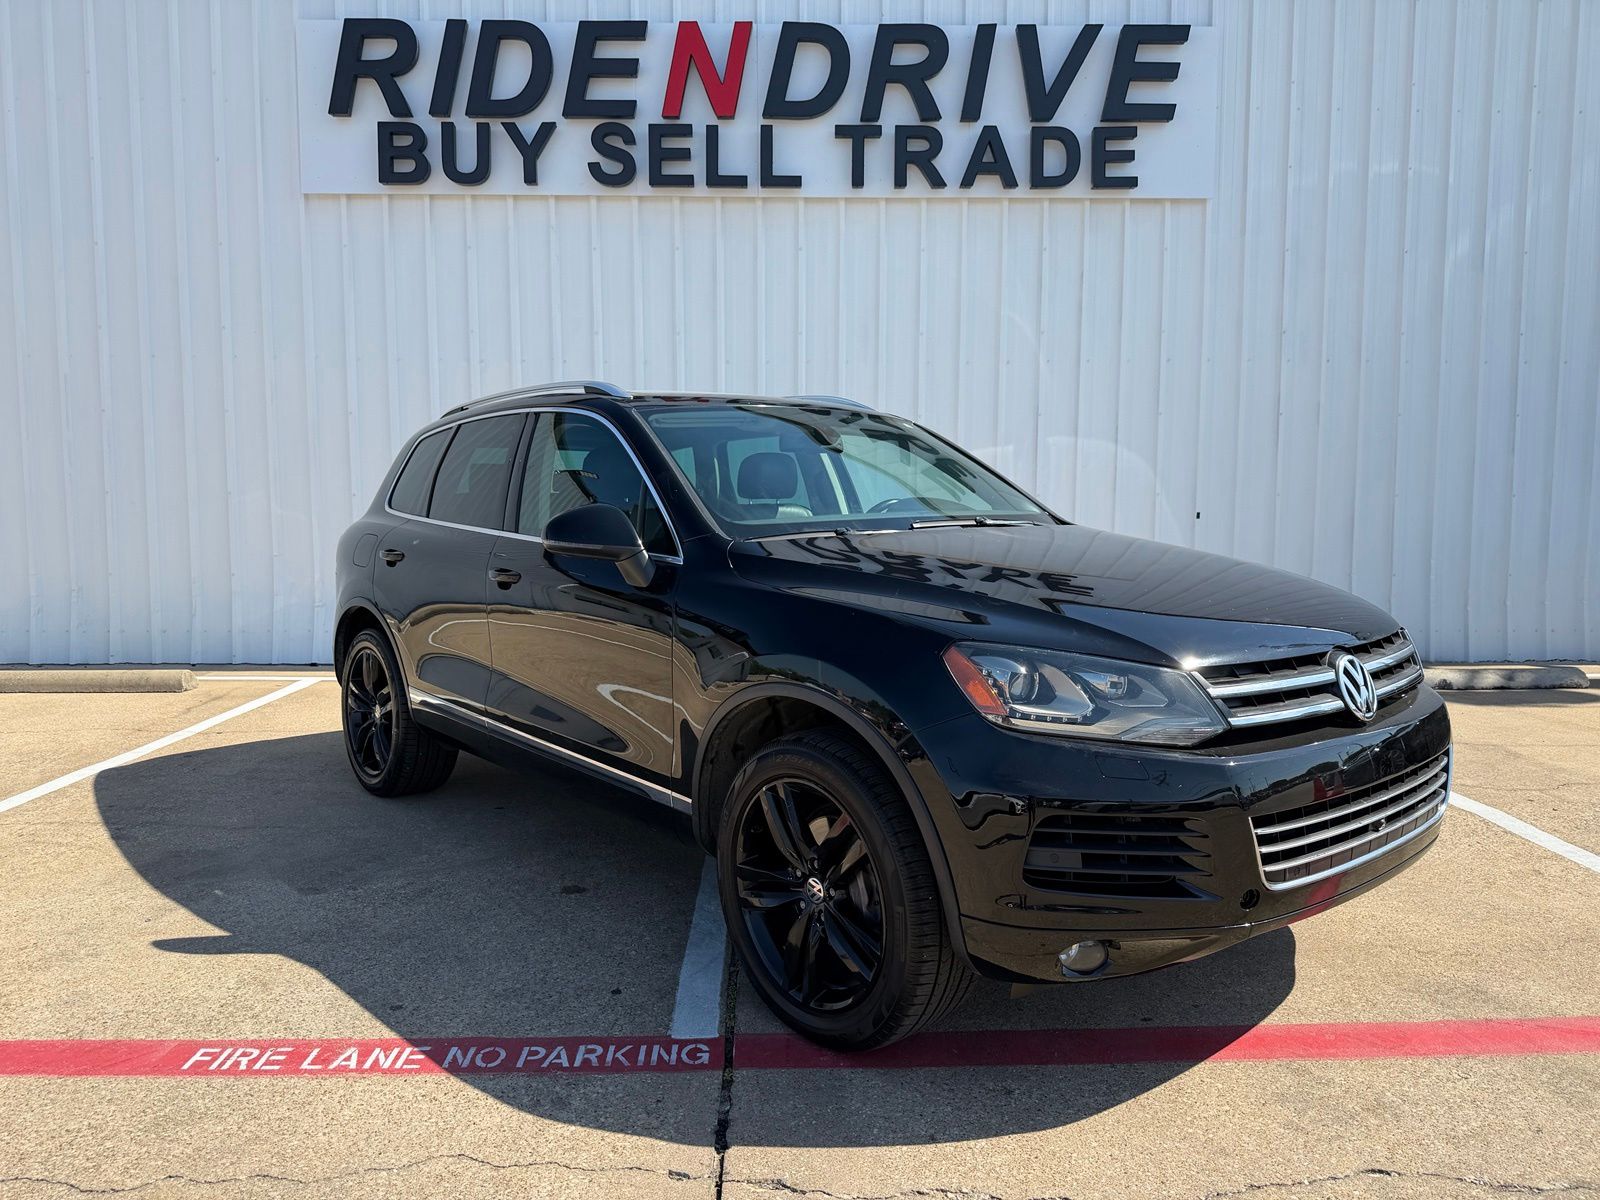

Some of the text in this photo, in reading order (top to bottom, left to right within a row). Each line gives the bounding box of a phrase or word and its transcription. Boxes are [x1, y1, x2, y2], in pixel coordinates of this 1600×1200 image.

[377, 121, 1138, 190] BUY SELL TRADE
[181, 1043, 710, 1070] FIRE LANE NO PARKING
